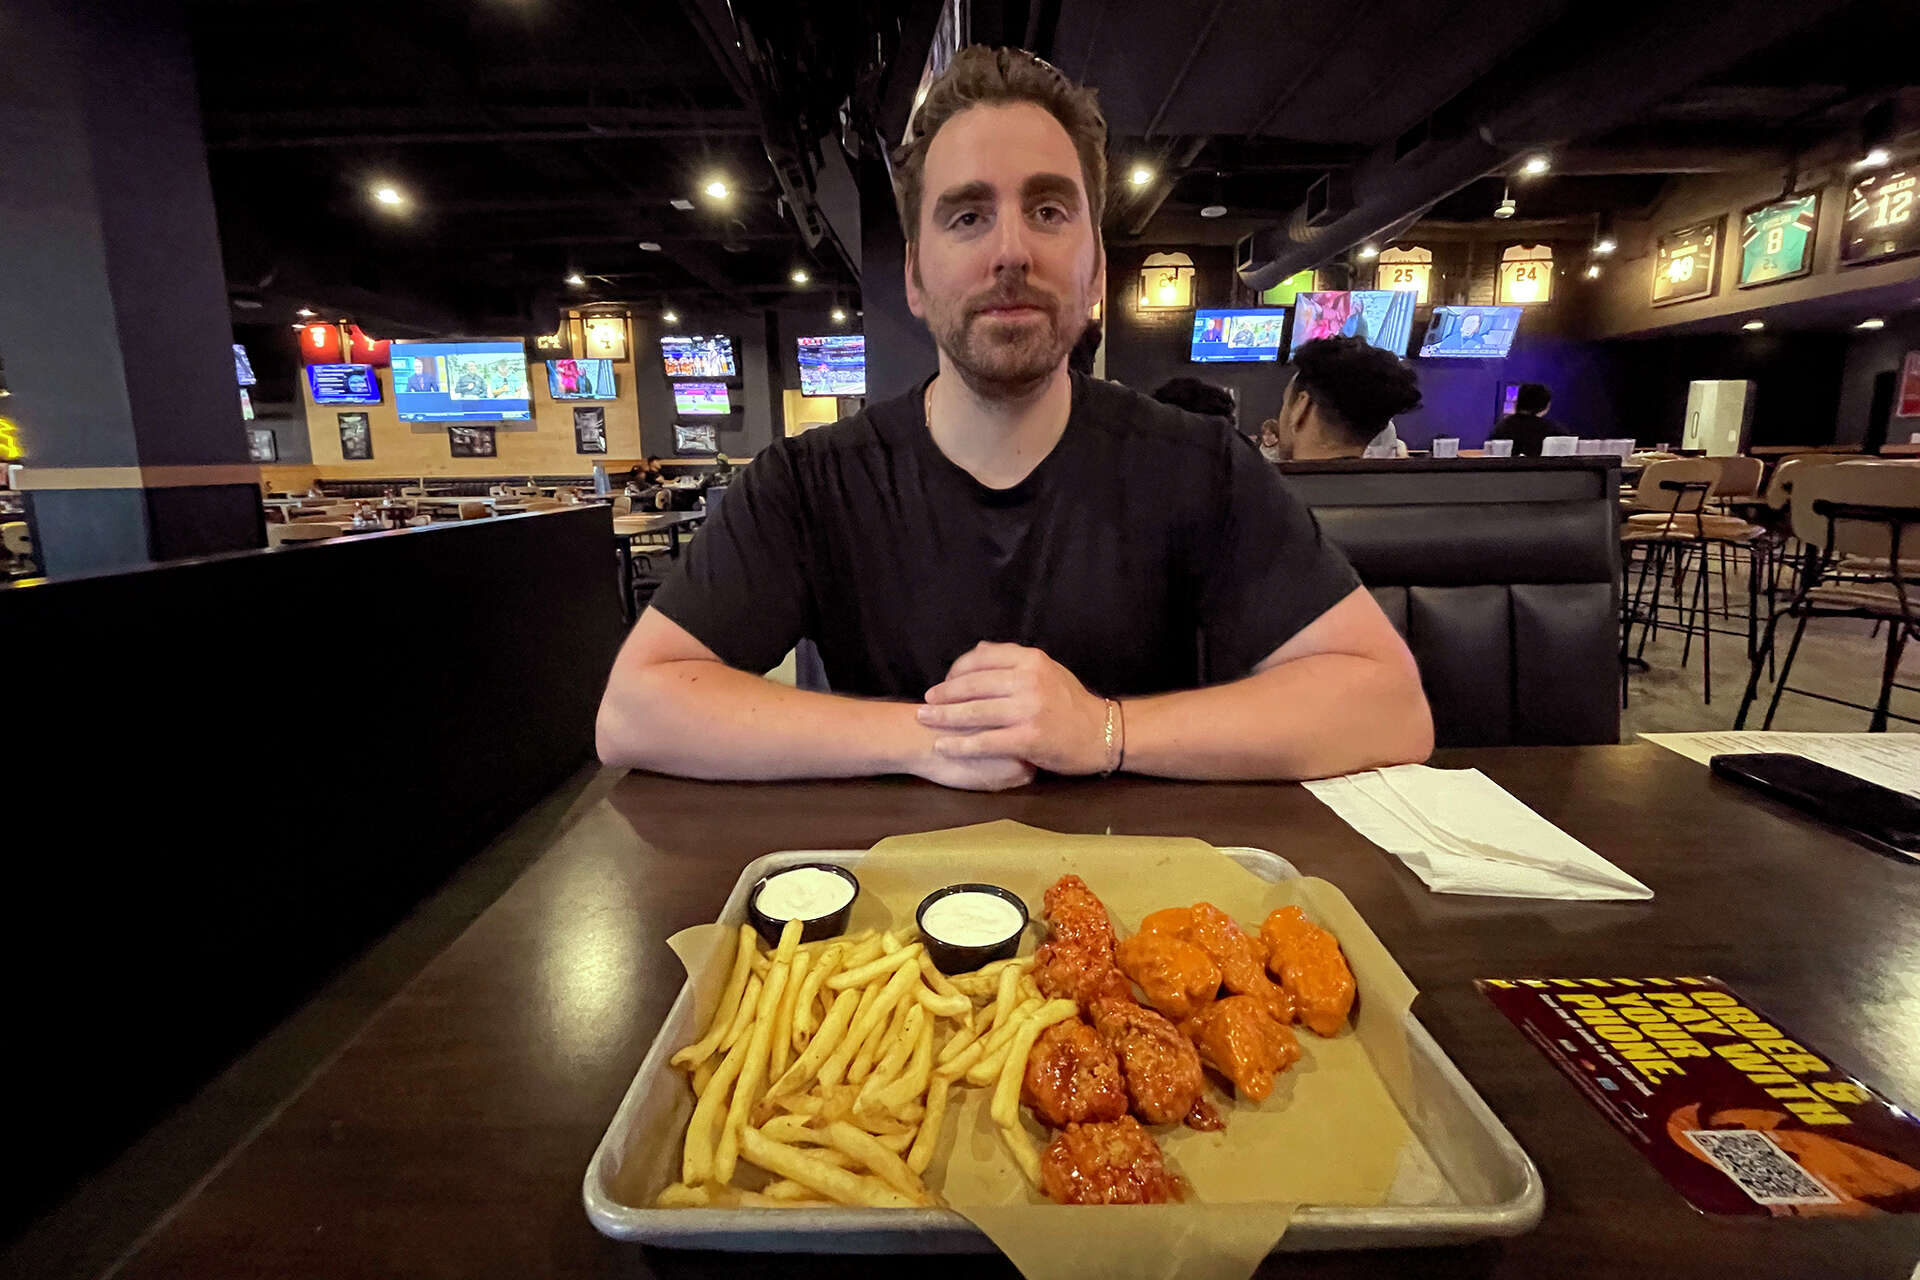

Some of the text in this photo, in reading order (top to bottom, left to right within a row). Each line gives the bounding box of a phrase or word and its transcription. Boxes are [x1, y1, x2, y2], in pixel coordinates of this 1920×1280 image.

[1873, 190, 1913, 228] 12
[1767, 226, 1784, 255] 8
[1393, 268, 1414, 283] 25
[1515, 266, 1537, 282] 24
[1556, 993, 1687, 1085] PHONE.
[1604, 992, 1712, 1058] YOUR
[1689, 991, 1831, 1075] ORDER
[1810, 1081, 1872, 1105] &
[1643, 992, 1738, 1036] PAY
[1711, 1042, 1854, 1125] WITH
